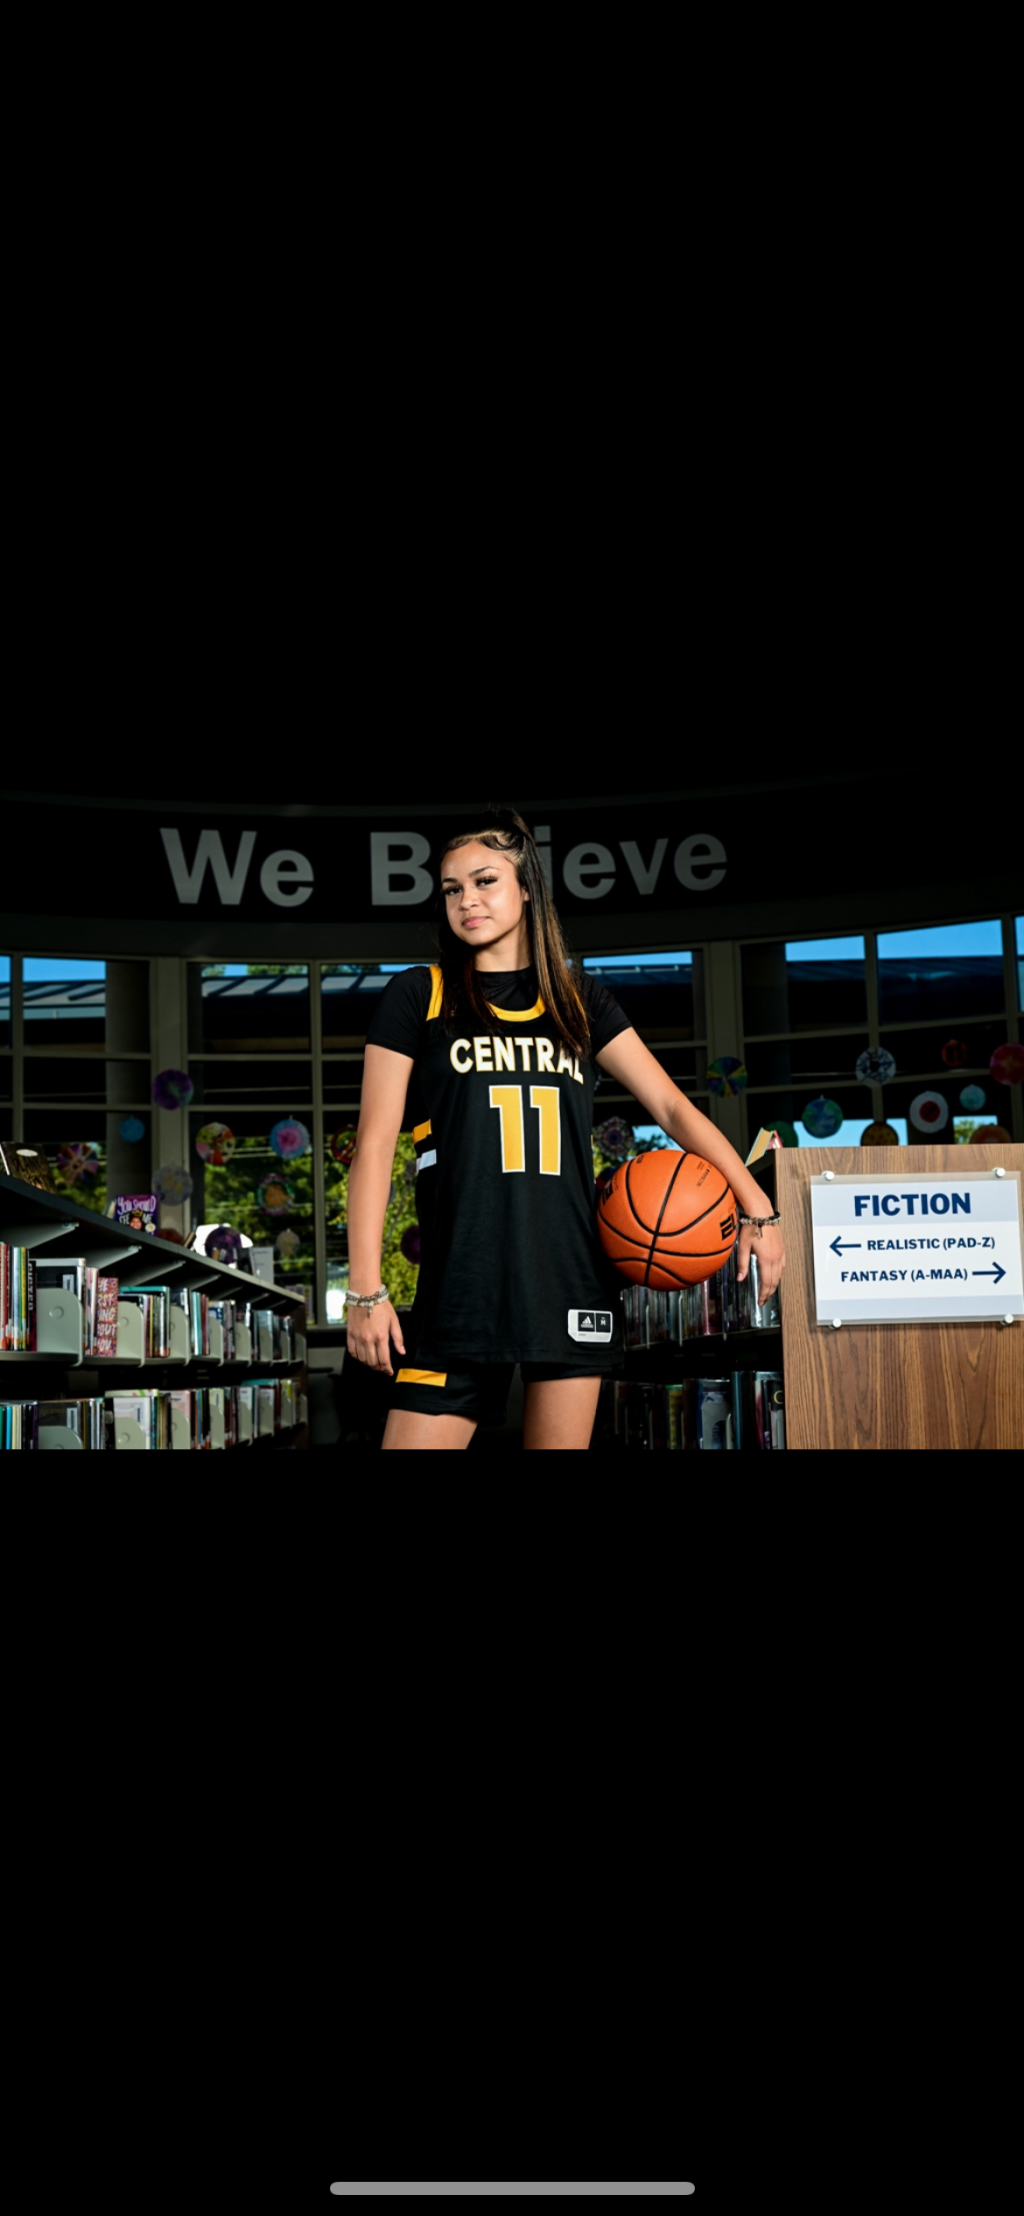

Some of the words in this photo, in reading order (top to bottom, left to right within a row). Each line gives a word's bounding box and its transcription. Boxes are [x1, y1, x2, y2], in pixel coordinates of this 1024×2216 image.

[159, 827, 315, 907] We
[369, 824, 728, 906] Bieve
[450, 1036, 584, 1085] CENTRAL
[488, 1084, 561, 1176] 11
[853, 1192, 971, 1217] FICTION
[867, 1238, 941, 1251] REALISTIC
[943, 1236, 996, 1251] (PAD-Z)
[841, 1269, 908, 1282] FANTASY
[910, 1268, 968, 1283] (A-MAA)
